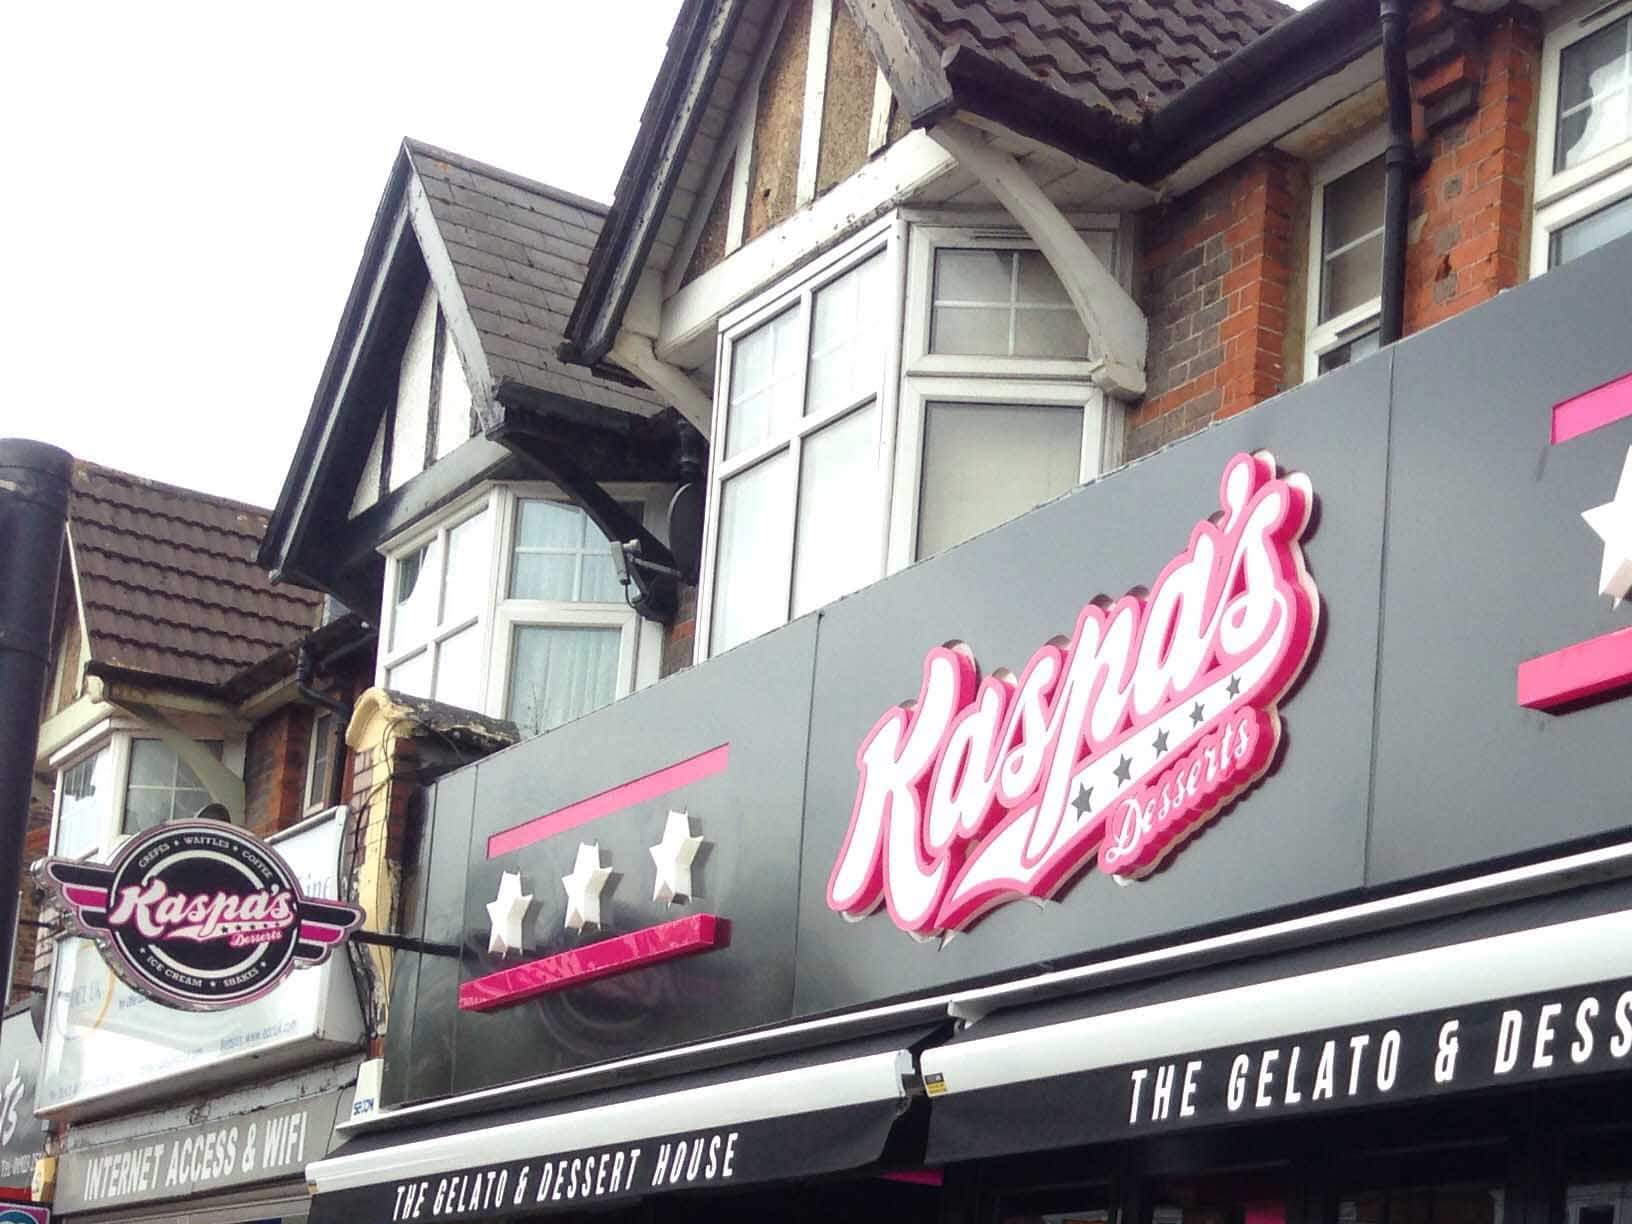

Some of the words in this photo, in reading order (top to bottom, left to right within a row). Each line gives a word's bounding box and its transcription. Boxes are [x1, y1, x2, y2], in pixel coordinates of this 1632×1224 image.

[828, 453, 1300, 932] Kaspa's
[1103, 706, 1260, 868] Desserts
[138, 843, 170, 868] CREPES
[183, 836, 230, 849] WAFFLES
[241, 850, 273, 879] COFFEE
[108, 879, 294, 938] Kaspa's
[230, 930, 283, 947] Desserts
[147, 956, 163, 972] ICE
[165, 968, 203, 987] CREAM
[223, 967, 259, 987] SHAKES
[1128, 1061, 1203, 1124] THE
[1226, 1029, 1401, 1113] GELATO
[1434, 1019, 1460, 1084] &
[83, 1144, 164, 1200] INTERNET
[165, 1120, 237, 1187] ACCESS
[242, 1129, 257, 1173] &
[262, 1112, 308, 1169] WIFI
[393, 1182, 429, 1221] THE
[432, 1168, 507, 1216] GELATO
[513, 1167, 531, 1204] &
[536, 1148, 641, 1202] DESSERT
[652, 1132, 739, 1186] HOUSE
